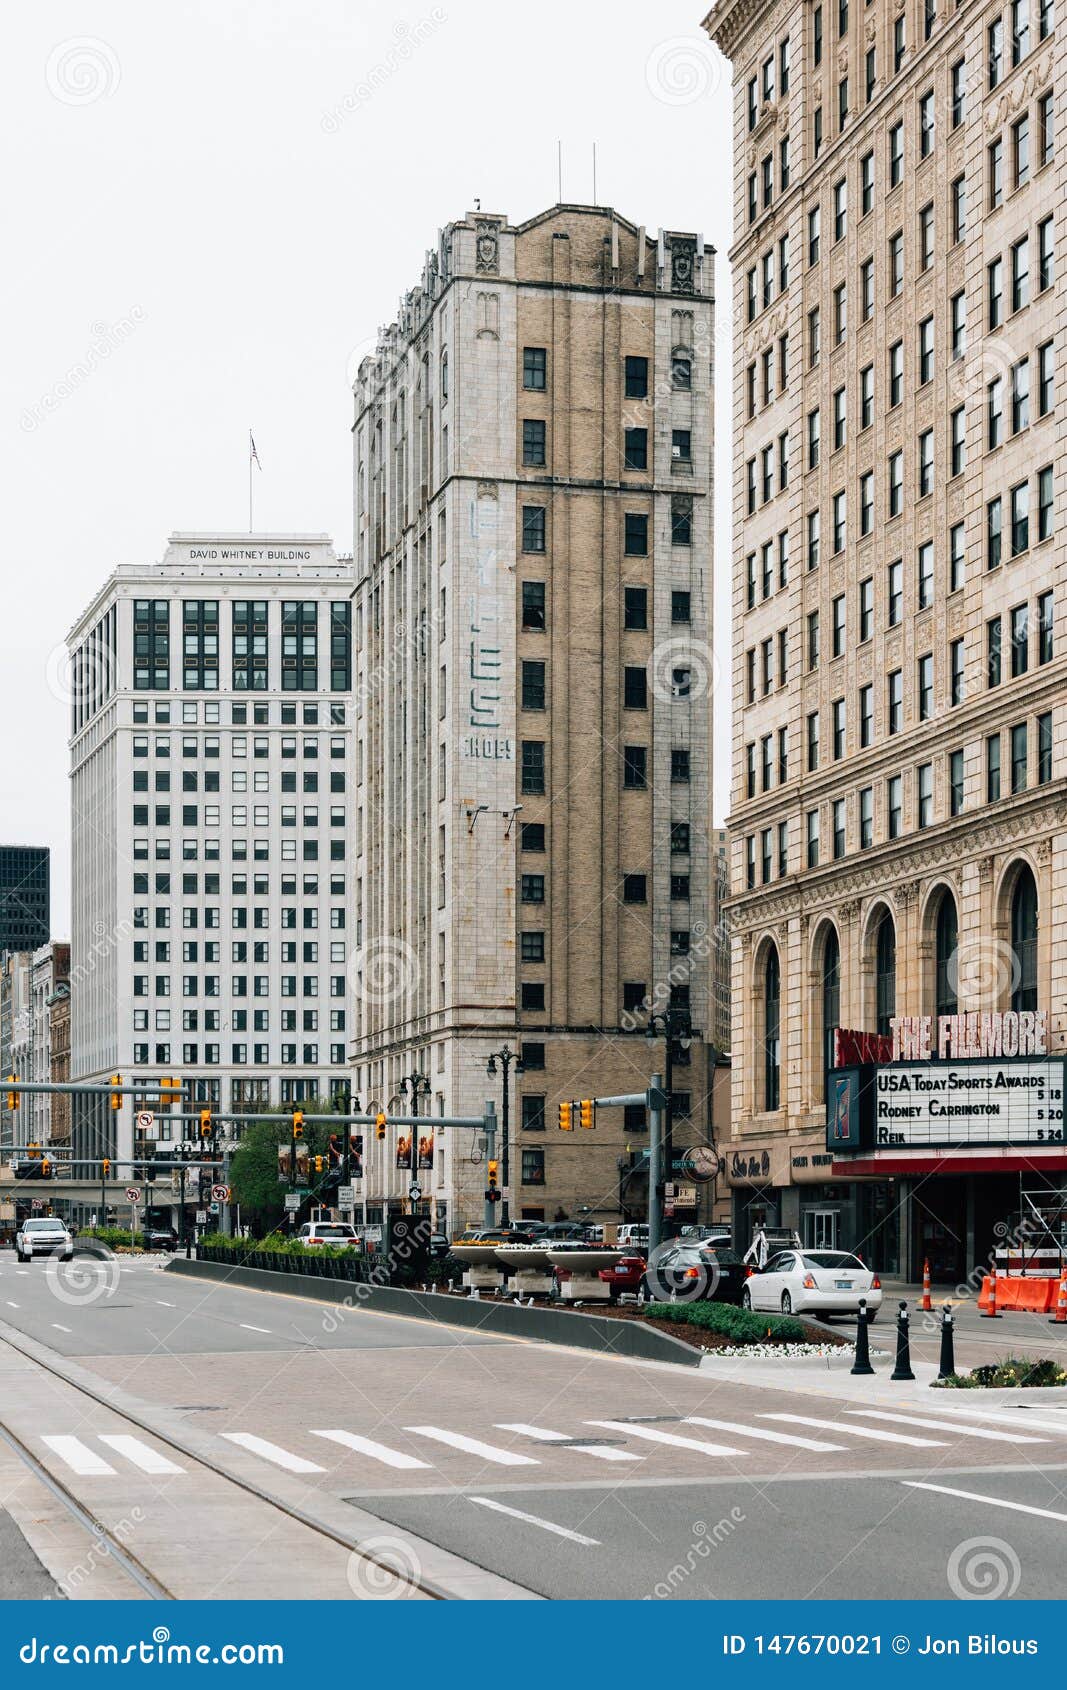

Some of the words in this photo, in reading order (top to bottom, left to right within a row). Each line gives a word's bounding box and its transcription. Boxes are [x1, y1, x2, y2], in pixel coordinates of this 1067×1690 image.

[190, 551, 217, 559] DAVID
[222, 551, 264, 559] WHITNEY
[268, 551, 311, 560] BUILDING
[889, 1016, 932, 1062] THE
[938, 1010, 1048, 1061] FILLMORE
[878, 1074, 910, 1092] USA
[948, 1072, 993, 1090] SPORTS
[994, 1071, 1045, 1088] AWARDS
[1050, 1089, 1061, 1100] 18
[878, 1101, 922, 1118] RODNEY
[928, 1100, 1000, 1116] CARRINGTON
[1048, 1109, 1063, 1120] 20
[1048, 1130, 1062, 1140] 24
